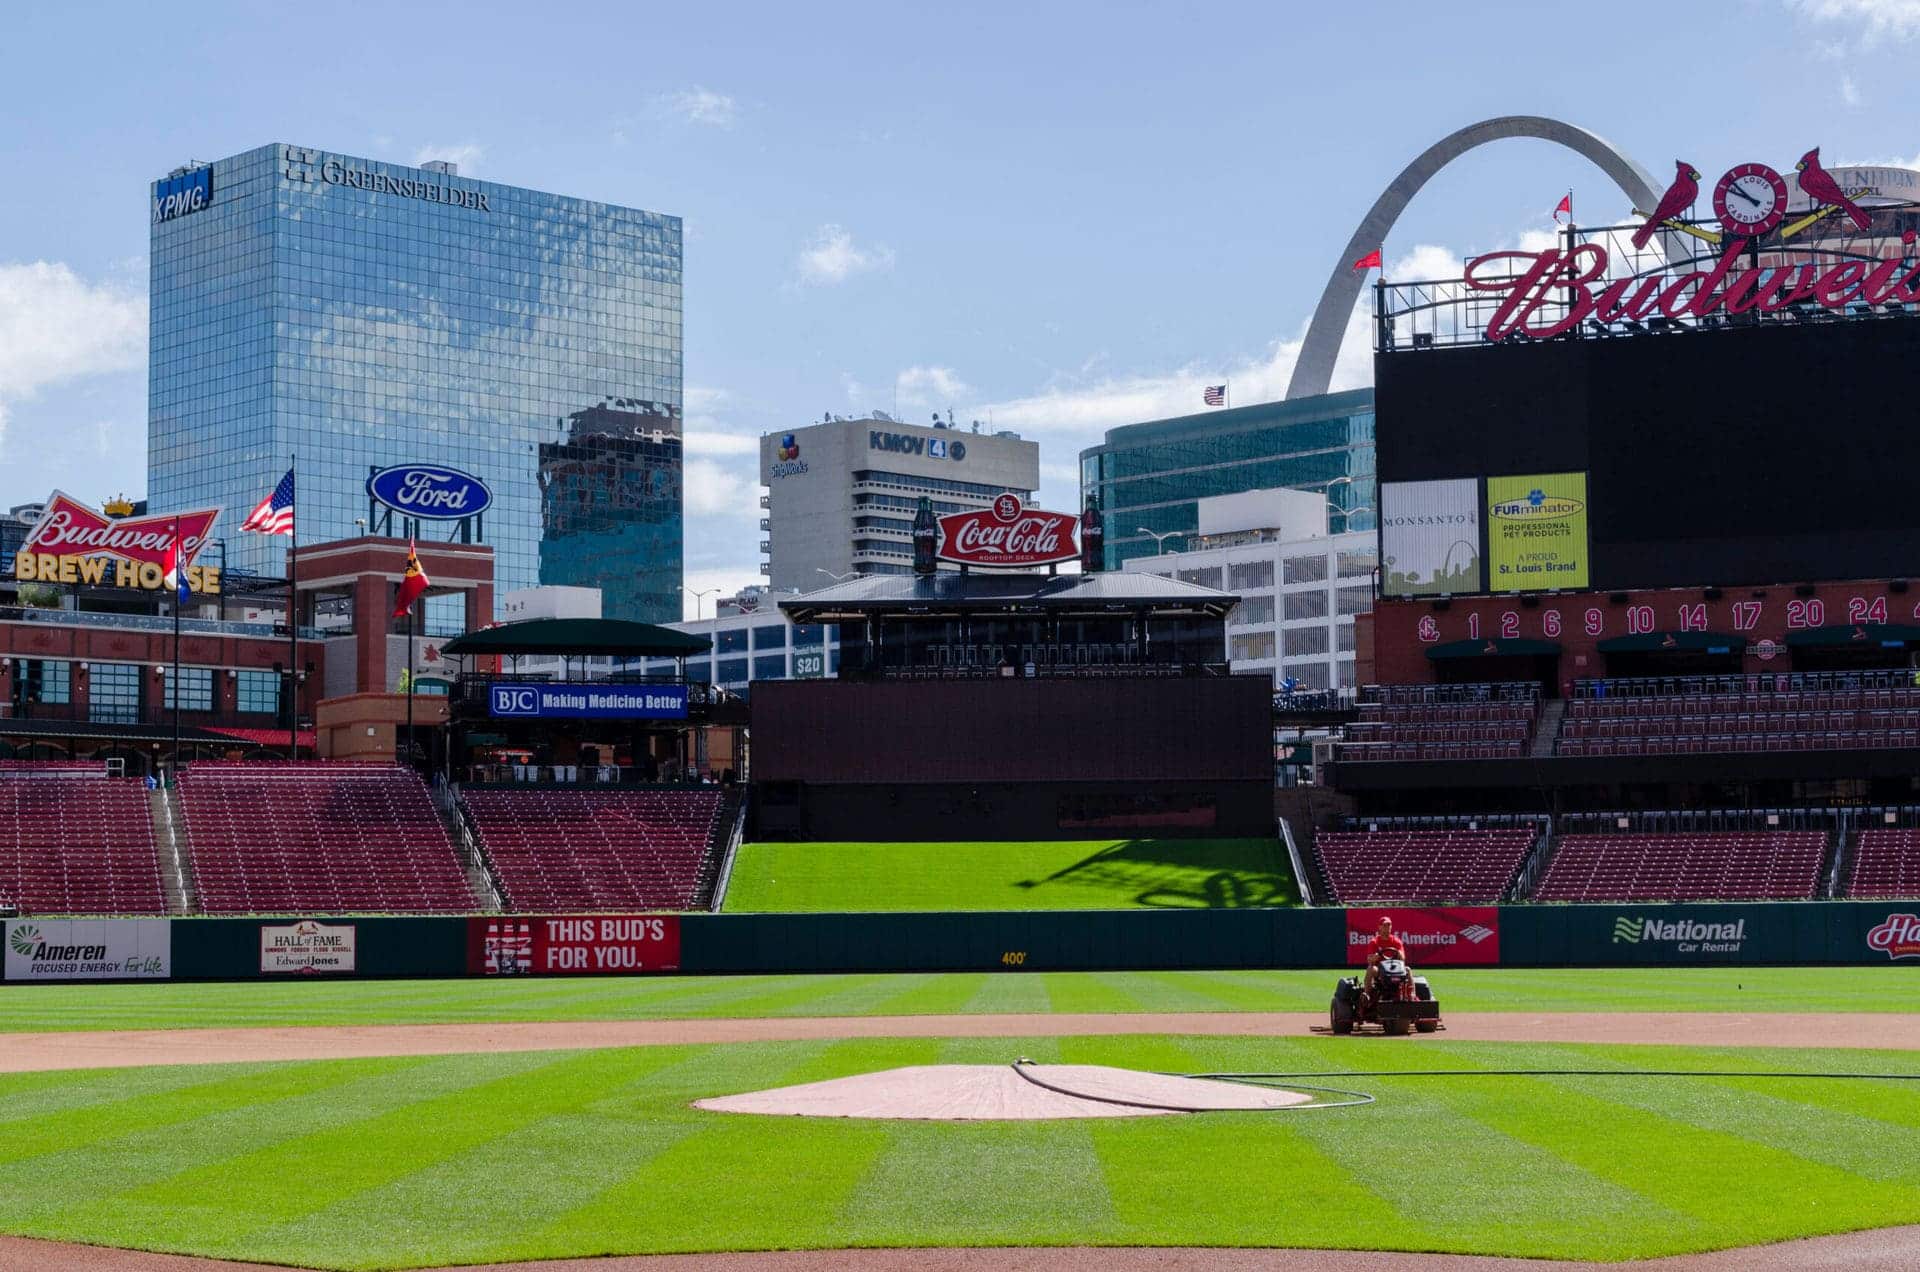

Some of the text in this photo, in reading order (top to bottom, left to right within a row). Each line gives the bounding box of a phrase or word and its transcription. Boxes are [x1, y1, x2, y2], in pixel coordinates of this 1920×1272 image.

[321, 161, 490, 212] GREENSFELDER
[152, 186, 204, 223] KPMG
[869, 430, 945, 457] KMOV 4
[397, 470, 469, 509] Ford
[1494, 503, 1577, 516] FURminator
[1383, 514, 1465, 527] MONSANTO
[1503, 522, 1571, 532] PROFESSIONAL
[17, 509, 216, 554] Budweier
[955, 517, 1063, 554] Coca-Cola
[1523, 529, 1571, 538] PRODUCTS
[1499, 560, 1577, 573] St. Louis Brand
[1526, 552, 1558, 561] PROUD
[15, 551, 108, 584] BREW
[1468, 613, 1479, 640] 1
[1502, 611, 1520, 639] 2
[1543, 609, 1561, 637] 6
[1585, 608, 1602, 636] 9
[1627, 605, 1655, 634] 10
[1679, 603, 1708, 632] 14
[1732, 601, 1762, 630] 17
[1787, 599, 1825, 629] 20
[1849, 596, 1888, 625] 24
[498, 691, 682, 712] BJC Making Medicine Better
[547, 919, 665, 941] THIS BUD'S
[1402, 931, 1457, 945] America
[1643, 919, 1744, 940] National
[32, 942, 106, 961] Ameren
[275, 936, 303, 947] HALL
[313, 936, 342, 946] FAME
[1678, 942, 1740, 952] Car Rental
[277, 956, 339, 965] Edward Jones
[547, 946, 643, 968] FOR YOU.
[31, 962, 77, 973] FOCUSED
